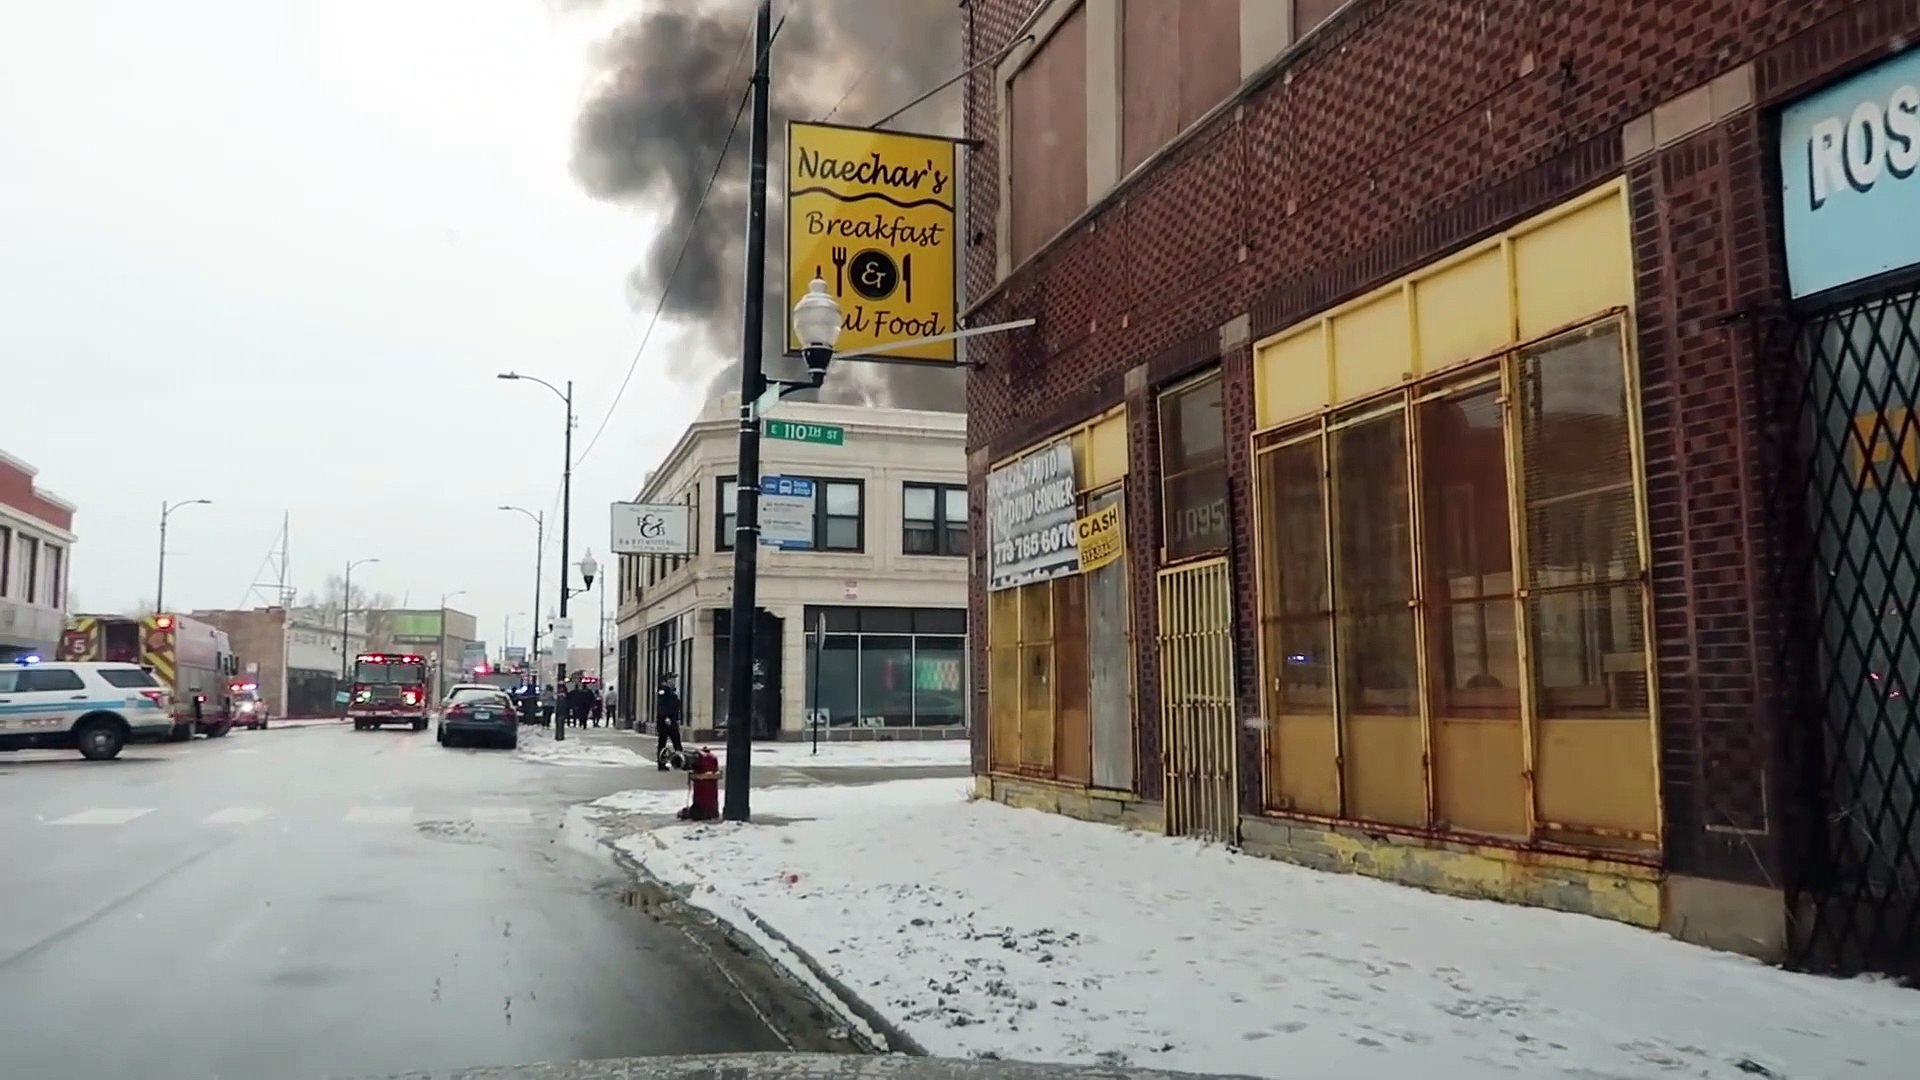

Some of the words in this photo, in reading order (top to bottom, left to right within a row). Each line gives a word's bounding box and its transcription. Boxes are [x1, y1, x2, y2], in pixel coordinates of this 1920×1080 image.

[1809, 85, 1920, 211] ROS
[798, 146, 948, 194] Naechar's
[806, 211, 944, 246] Breakfast
[861, 261, 886, 288] &
[874, 311, 946, 337] Food
[771, 424, 778, 434] E
[784, 424, 822, 440] 110TH
[826, 430, 839, 439] ST
[1034, 476, 1075, 514] CORNER
[1079, 508, 1118, 539] CASH
[73, 639, 86, 654] 5
